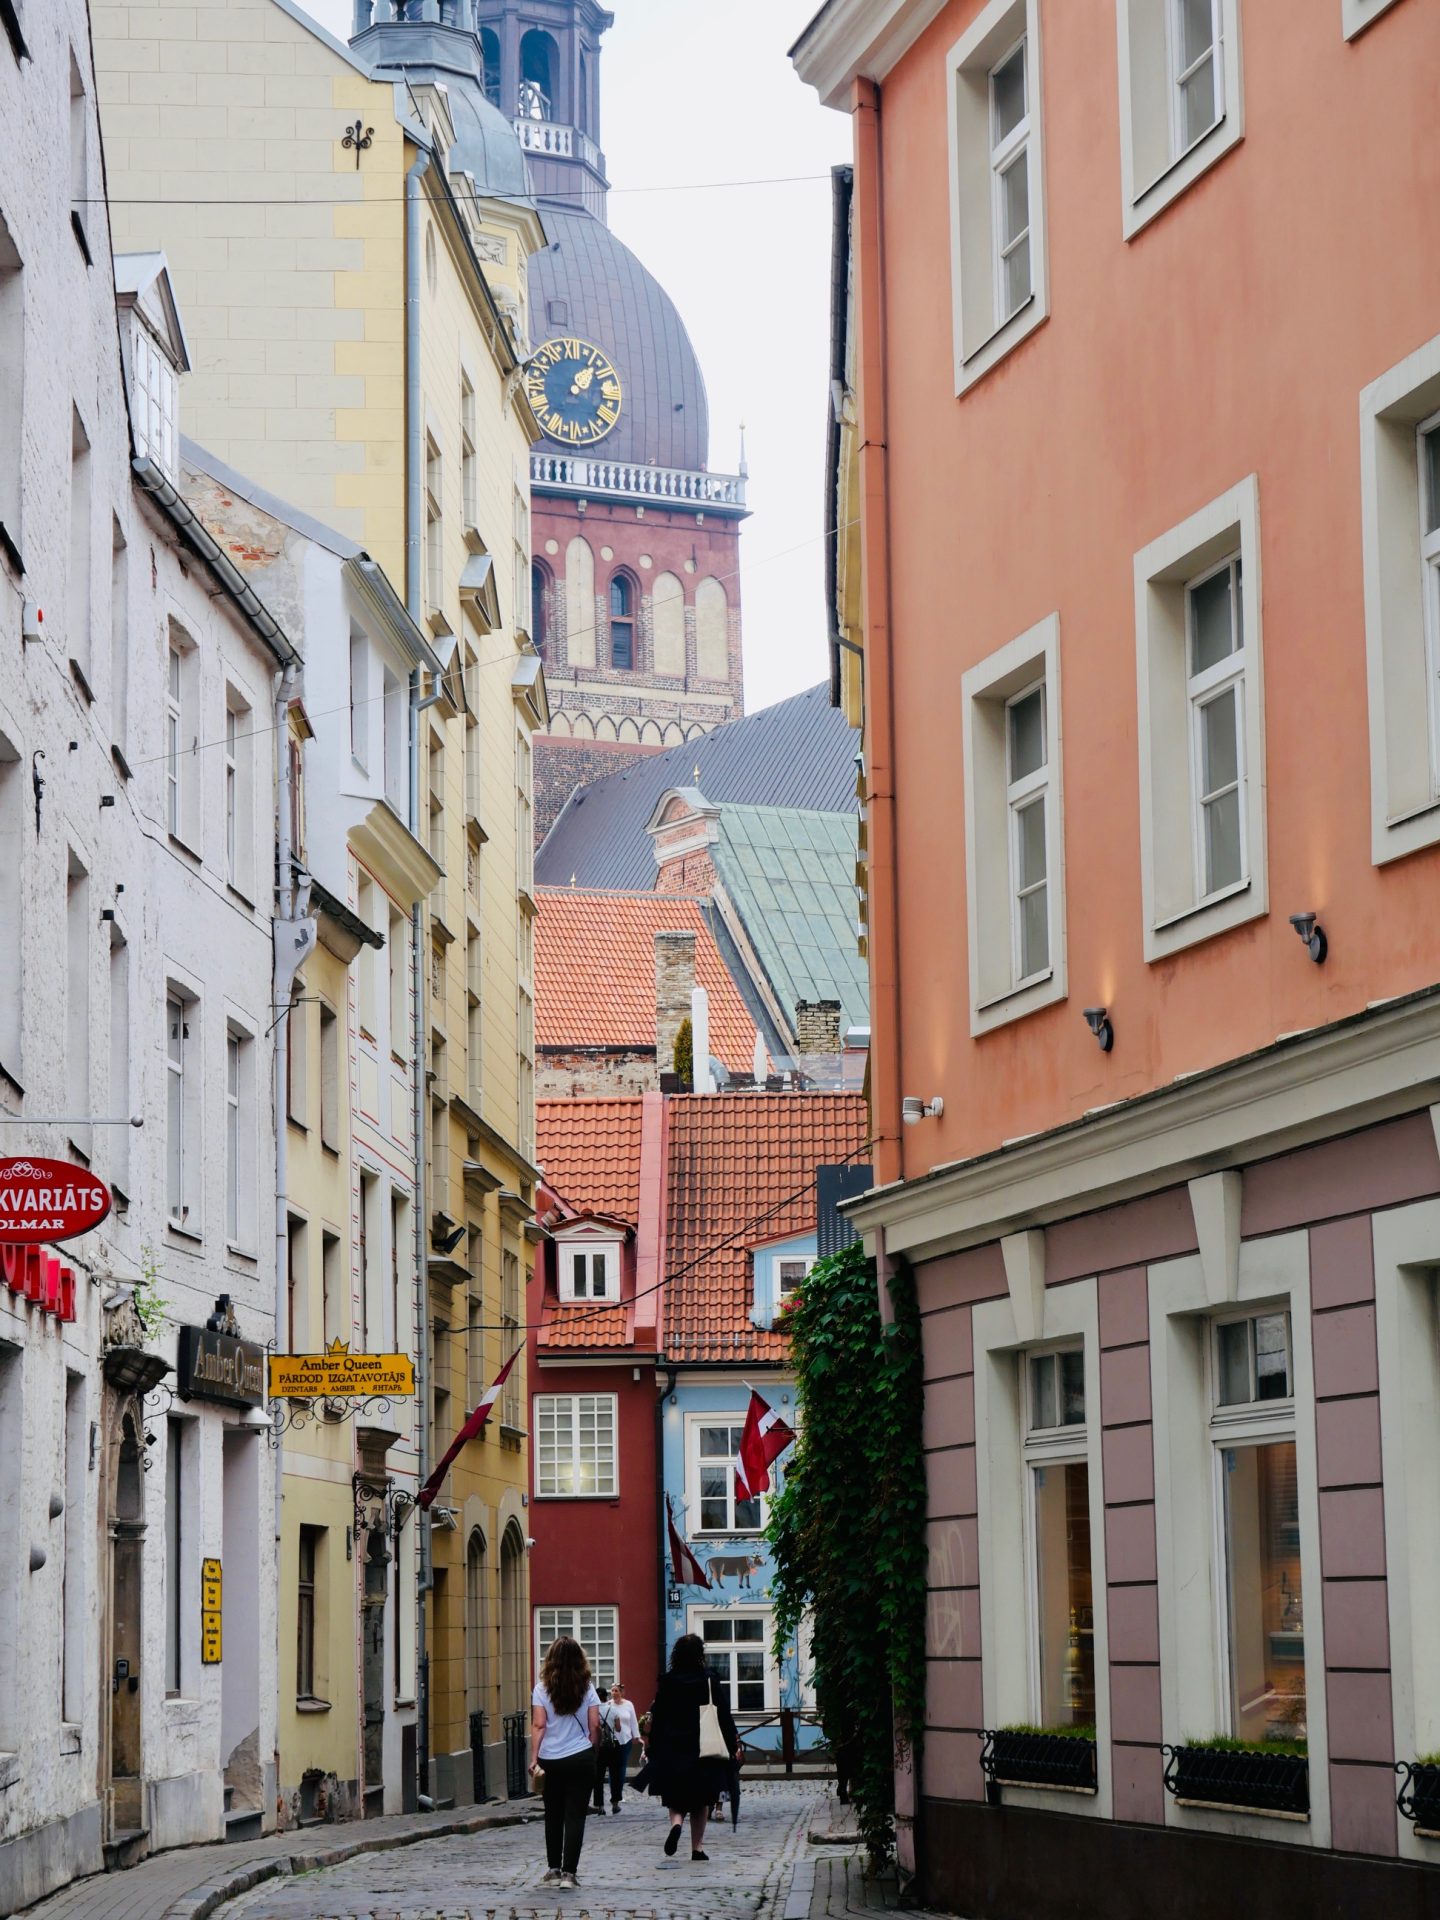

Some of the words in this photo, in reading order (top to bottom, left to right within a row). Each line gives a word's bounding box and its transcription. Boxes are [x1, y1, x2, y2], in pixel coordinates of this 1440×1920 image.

[541, 343, 561, 365] XI
[563, 340, 580, 360] XII
[588, 350, 598, 366] I
[531, 358, 550, 375] X
[595, 366, 614, 380] II
[569, 420, 582, 440] VI
[588, 418, 602, 438] V
[194, 1335, 235, 1384] Amber
[234, 1345, 263, 1397] Queen
[300, 1359, 340, 1371] Amber
[343, 1358, 382, 1370] Queen
[279, 1373, 323, 1384] PĀRDOD
[328, 1372, 405, 1384] IZGATAVOTĀJS
[281, 1385, 318, 1393] DZINTARS
[372, 1384, 403, 1392] ЯНТАРЬ
[670, 1592, 679, 1601] 16
